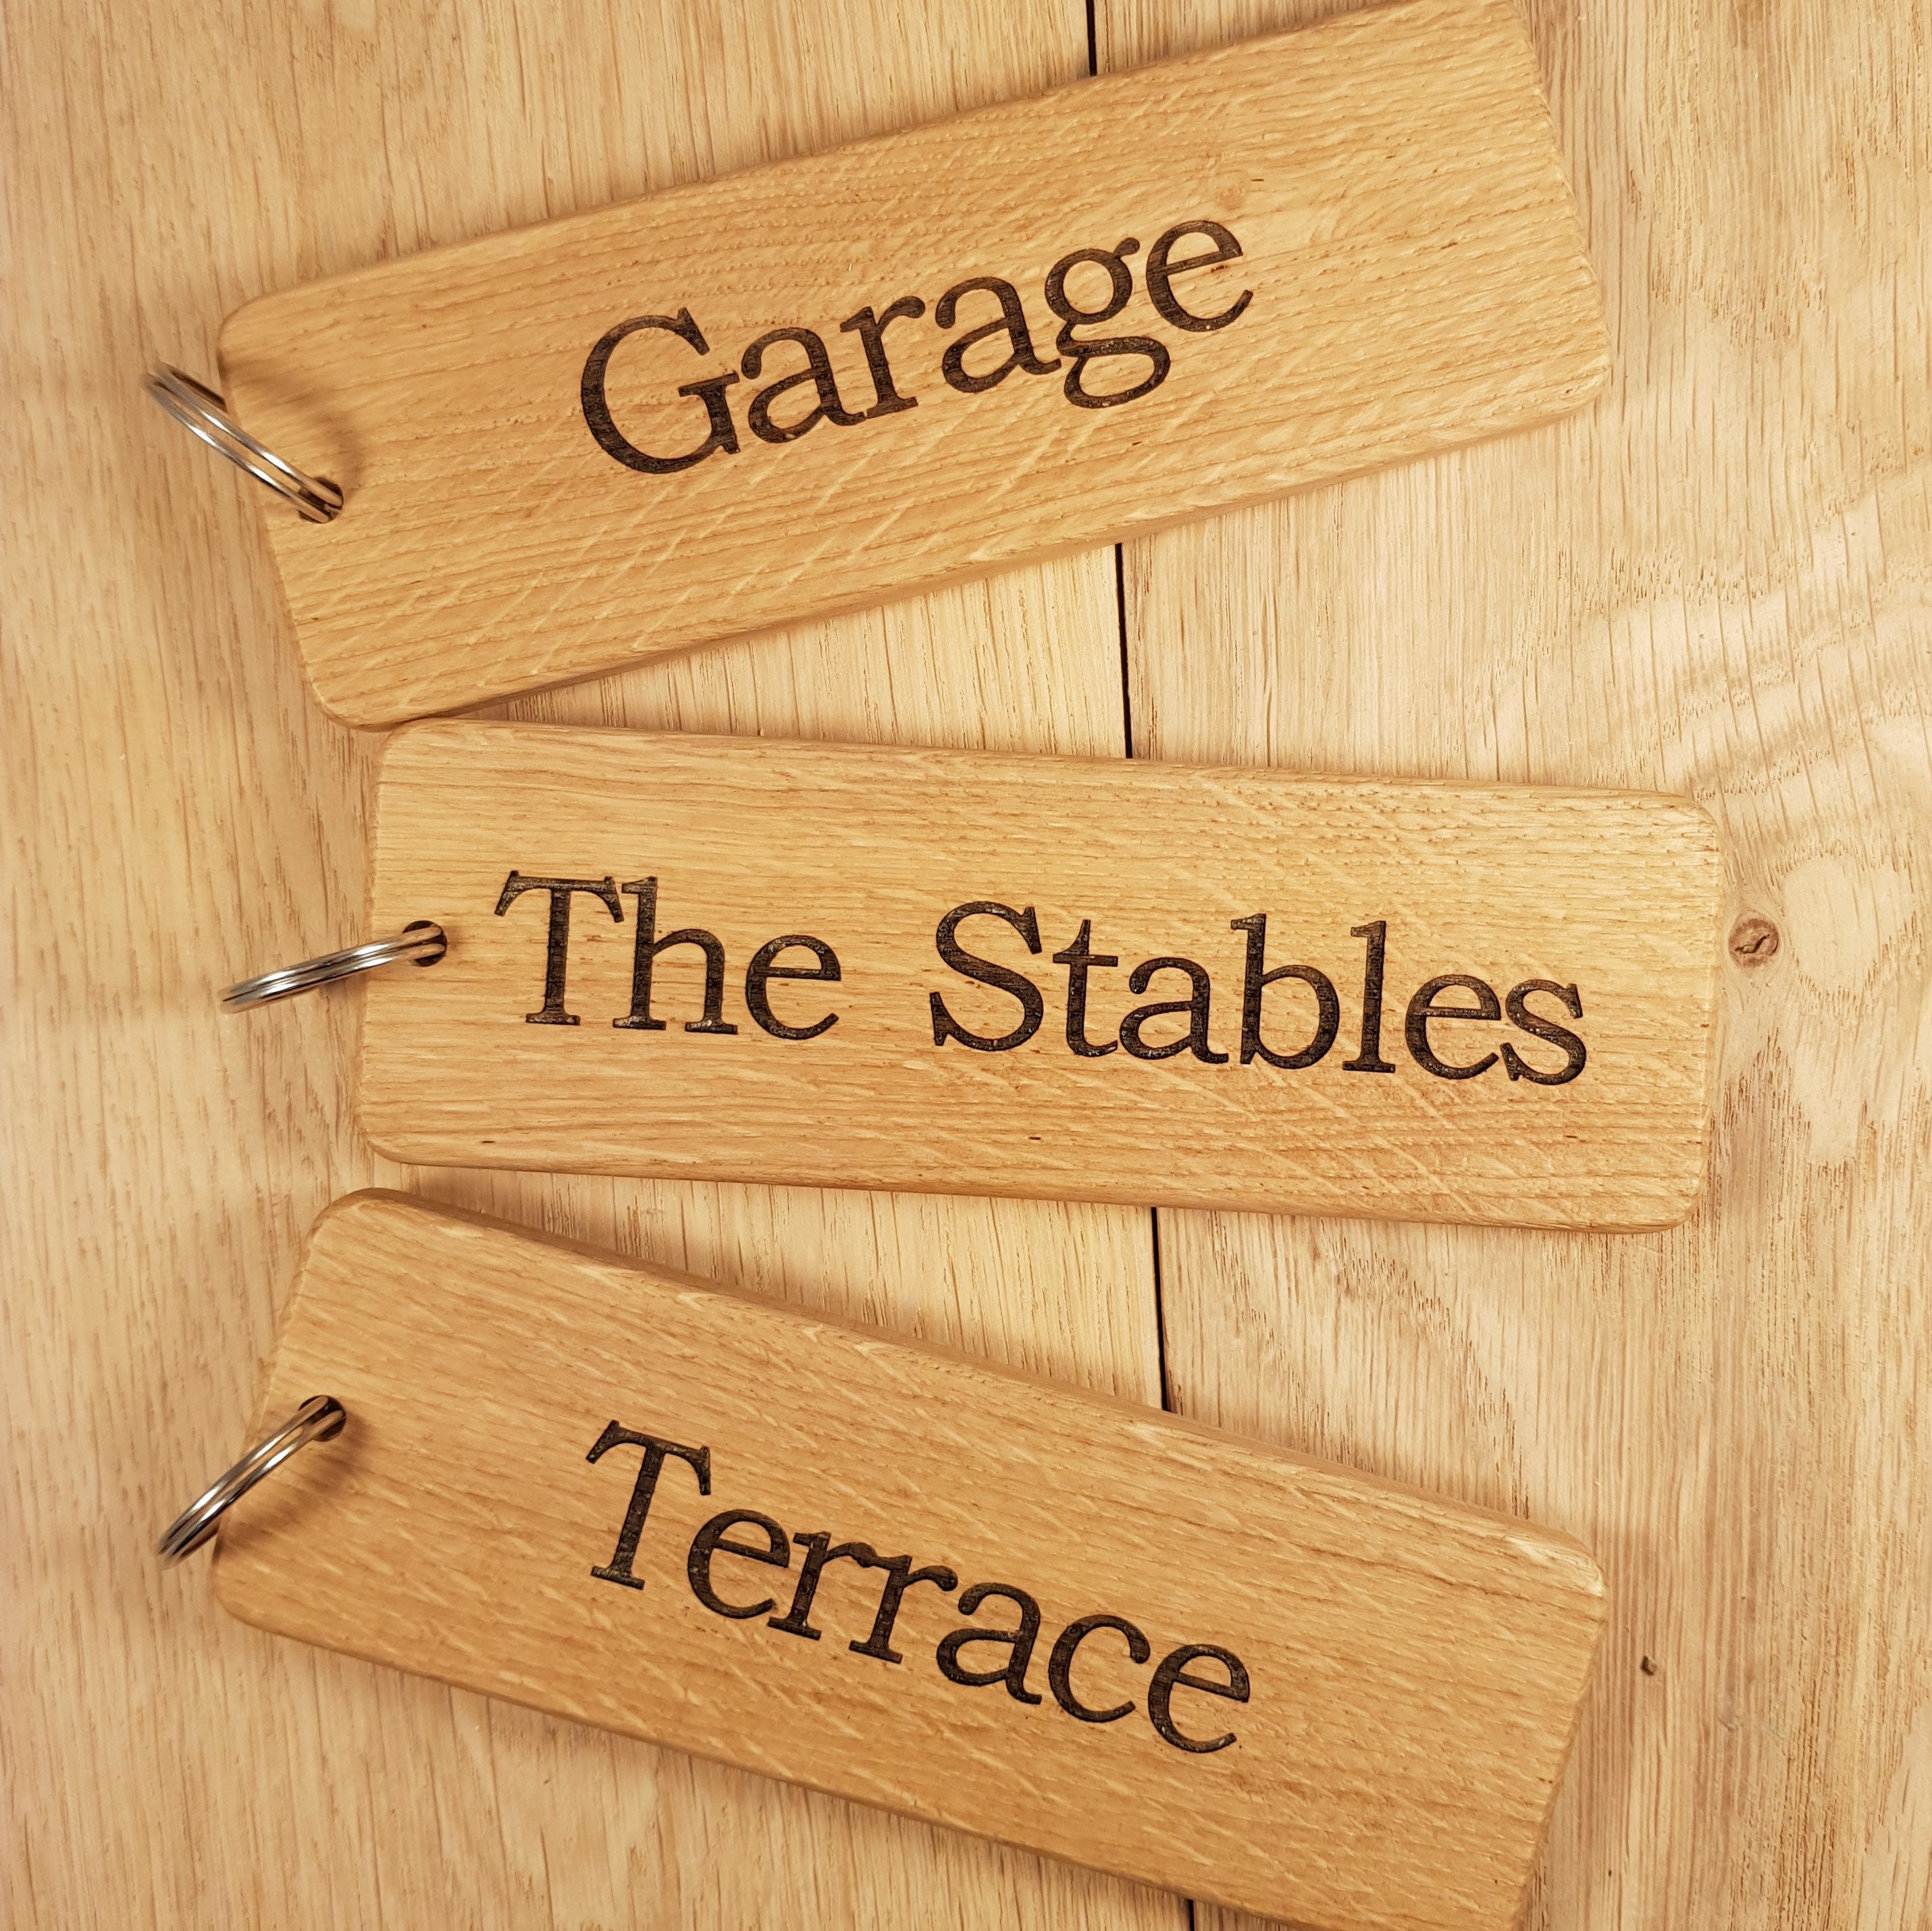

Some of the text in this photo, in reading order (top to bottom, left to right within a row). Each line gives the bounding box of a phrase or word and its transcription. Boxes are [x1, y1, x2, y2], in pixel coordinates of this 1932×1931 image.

[580, 219, 1253, 475] Garage
[494, 870, 1588, 1086] The Stables
[585, 1419, 1251, 1754] Terrace
